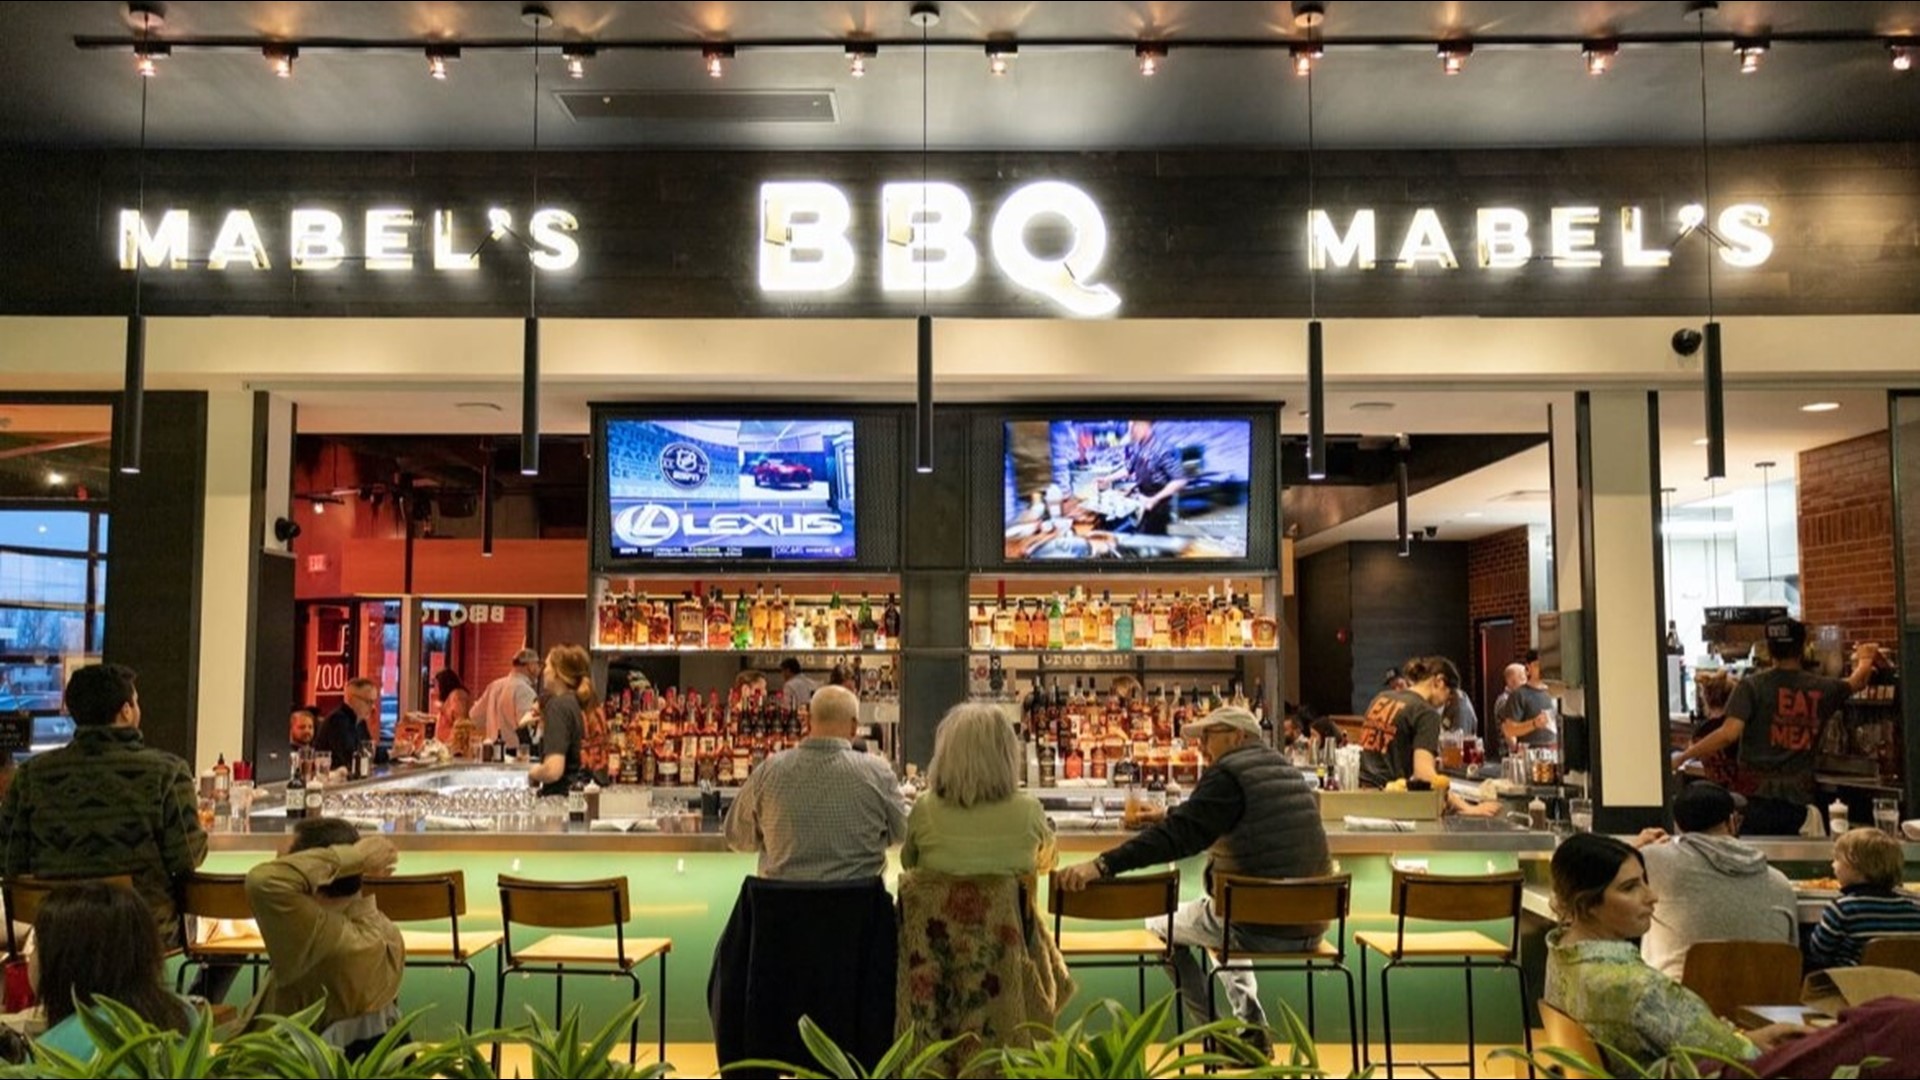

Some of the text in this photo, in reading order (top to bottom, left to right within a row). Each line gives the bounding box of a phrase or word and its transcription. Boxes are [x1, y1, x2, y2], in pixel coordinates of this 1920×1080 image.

[119, 181, 1773, 317] MABEL'S BBQ MABEL'S
[681, 513, 843, 536] LEXUS
[1367, 697, 1406, 725] EAT
[1778, 687, 1825, 720] EAT
